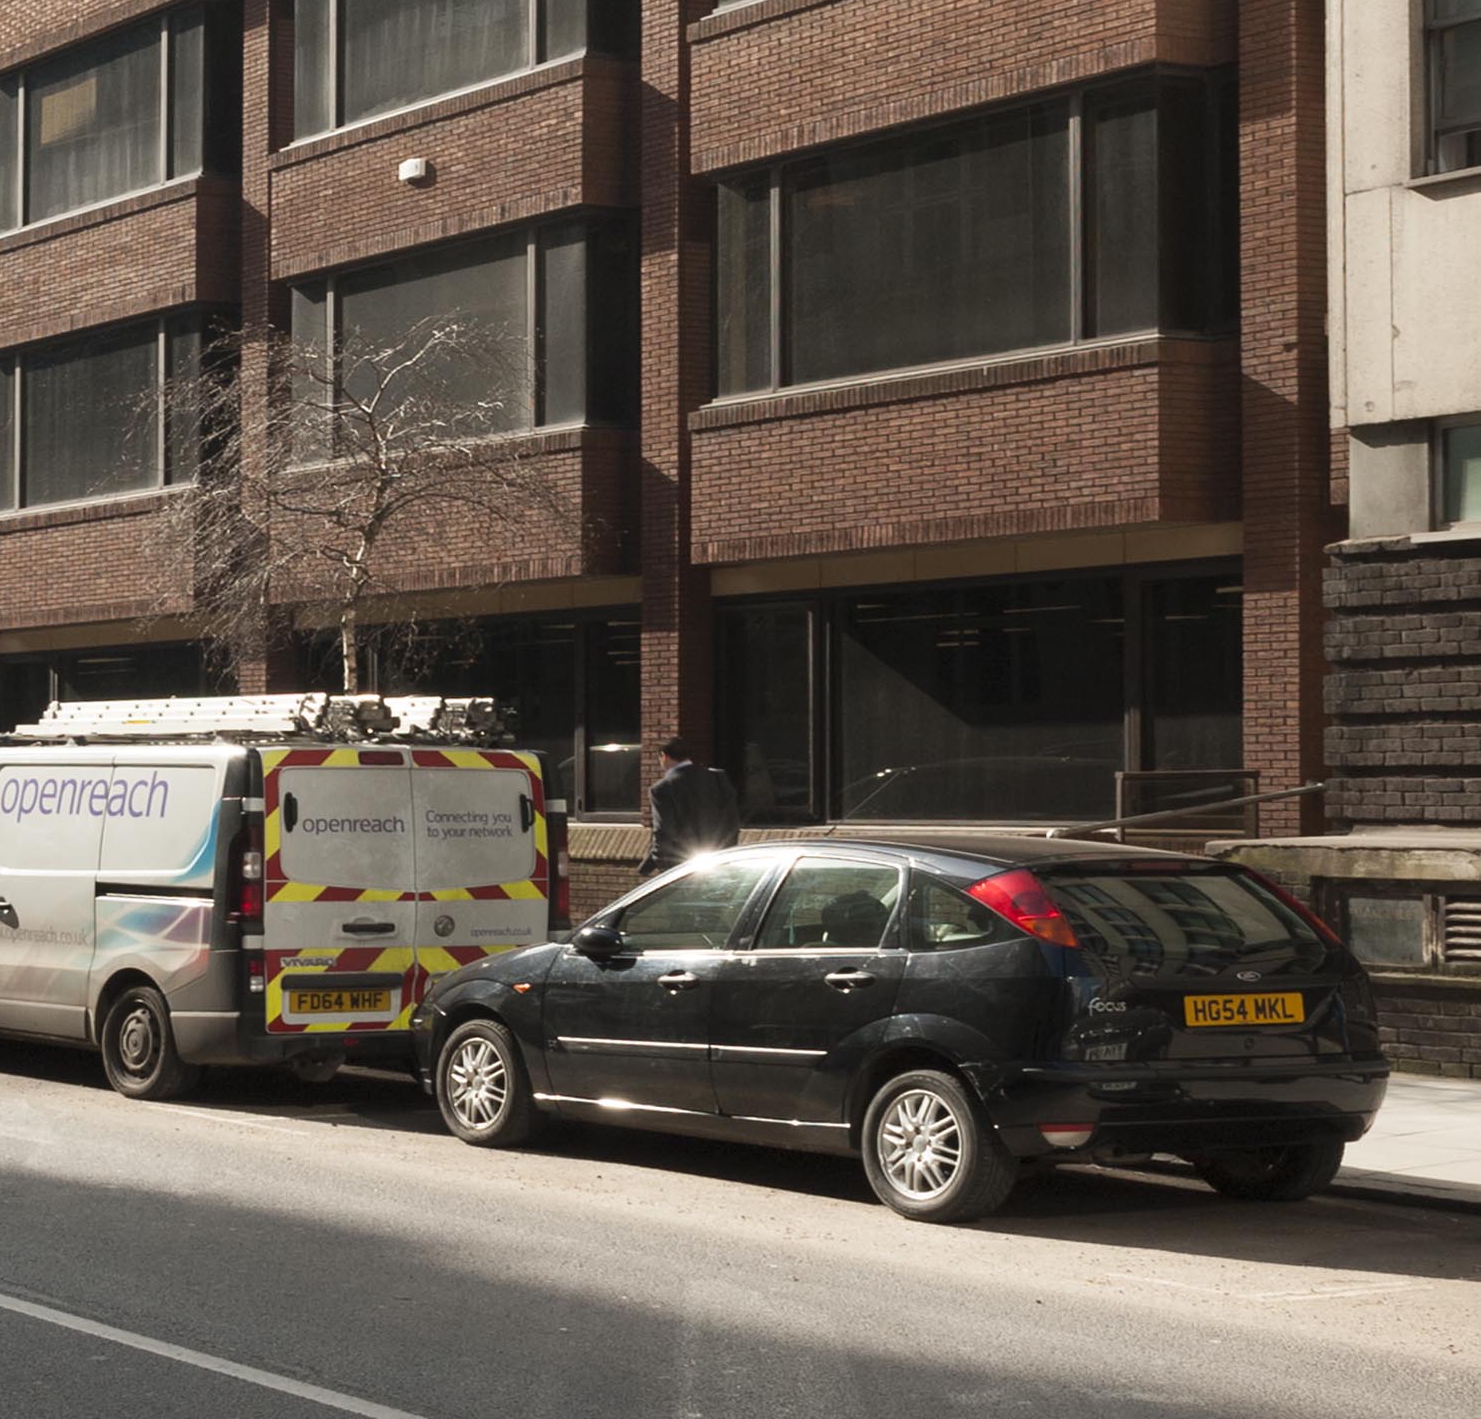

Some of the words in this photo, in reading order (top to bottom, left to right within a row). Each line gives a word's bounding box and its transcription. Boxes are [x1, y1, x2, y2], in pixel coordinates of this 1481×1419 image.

[1, 770, 169, 823] openreach
[302, 816, 405, 835] openreach
[426, 810, 488, 825] Connecting
[493, 813, 512, 825] you
[427, 827, 439, 838] to
[441, 828, 466, 841] your
[469, 825, 513, 838] network
[298, 993, 344, 1010] FD64
[350, 992, 383, 1009] WHF
[1194, 999, 1249, 1021] HG54
[1254, 997, 1295, 1020] MKL
